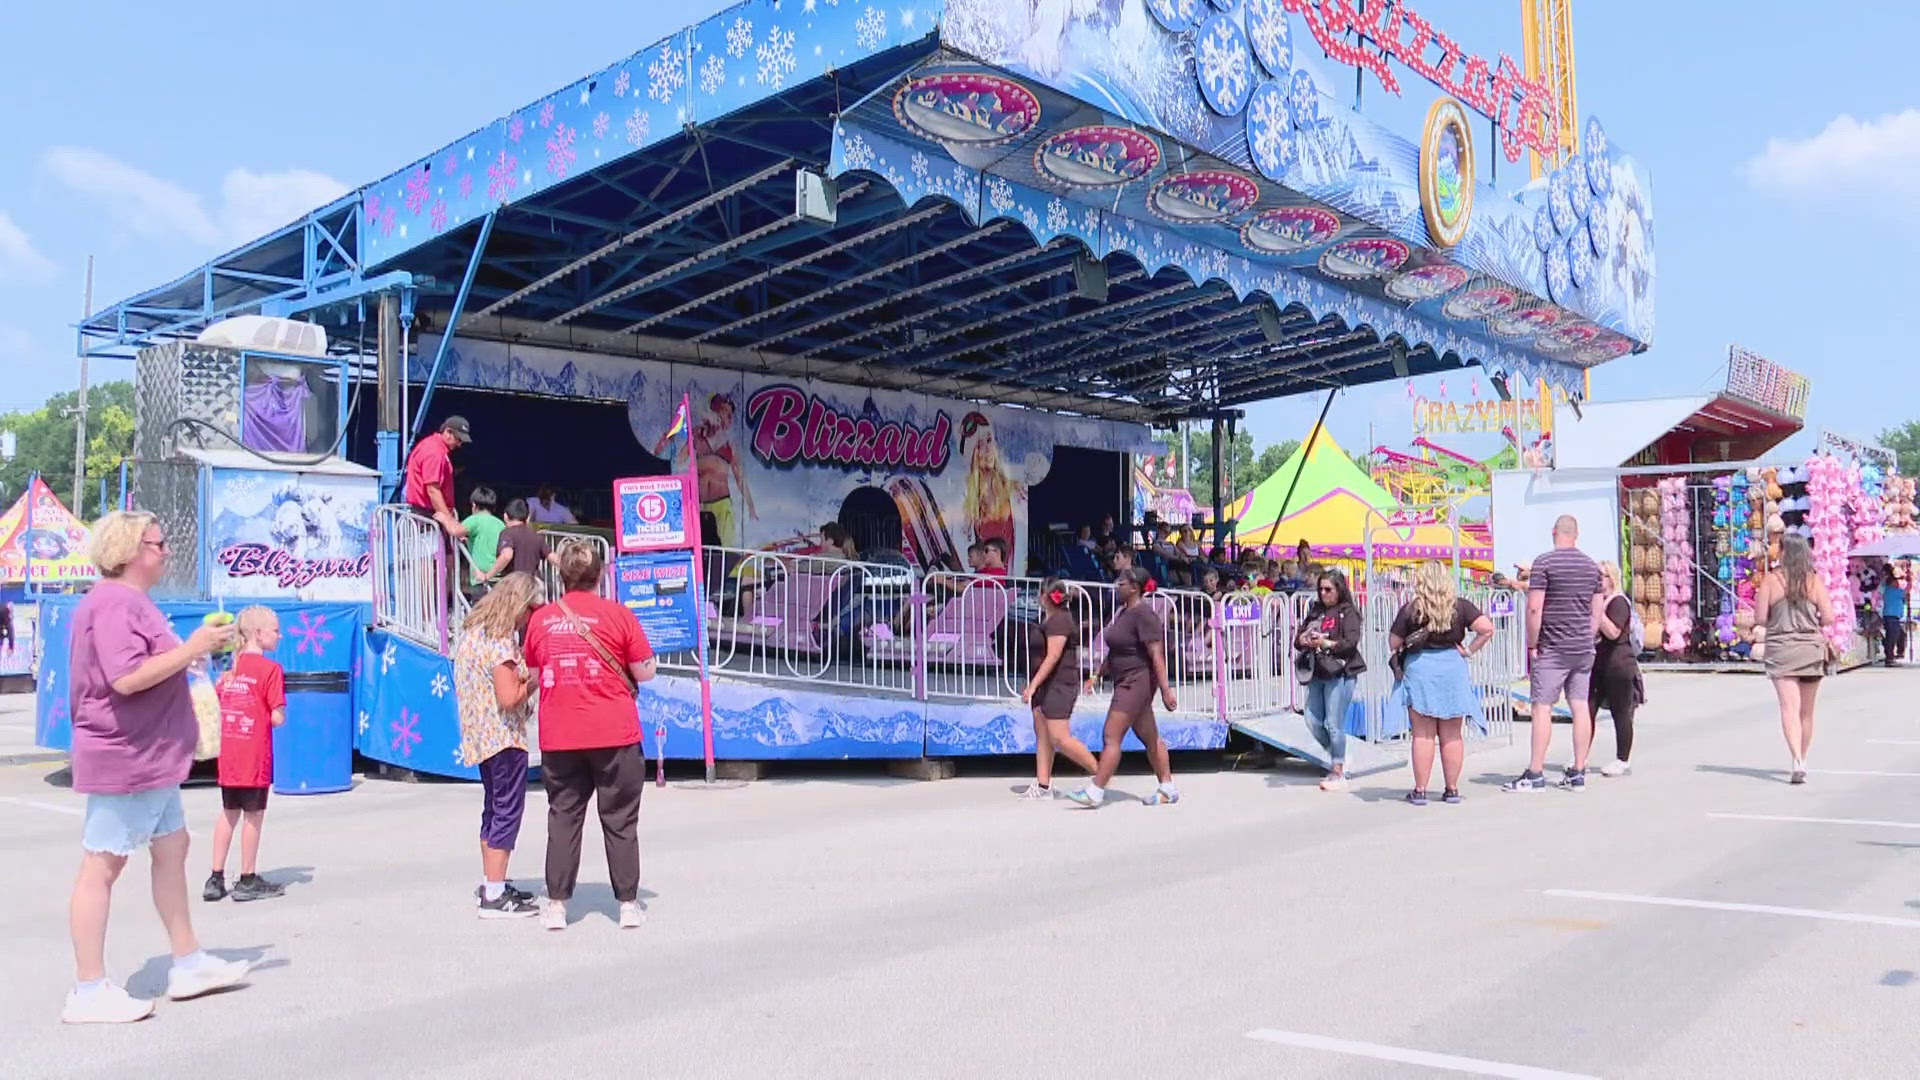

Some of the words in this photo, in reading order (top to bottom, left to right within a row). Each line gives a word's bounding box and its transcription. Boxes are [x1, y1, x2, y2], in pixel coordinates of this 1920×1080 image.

[1413, 396, 1494, 432] CRAZY
[748, 385, 951, 471] Blizzard
[640, 499, 658, 517] 15
[636, 522, 670, 534] TICKETS
[218, 543, 372, 588] Blizzard
[1232, 605, 1252, 618] EXIT
